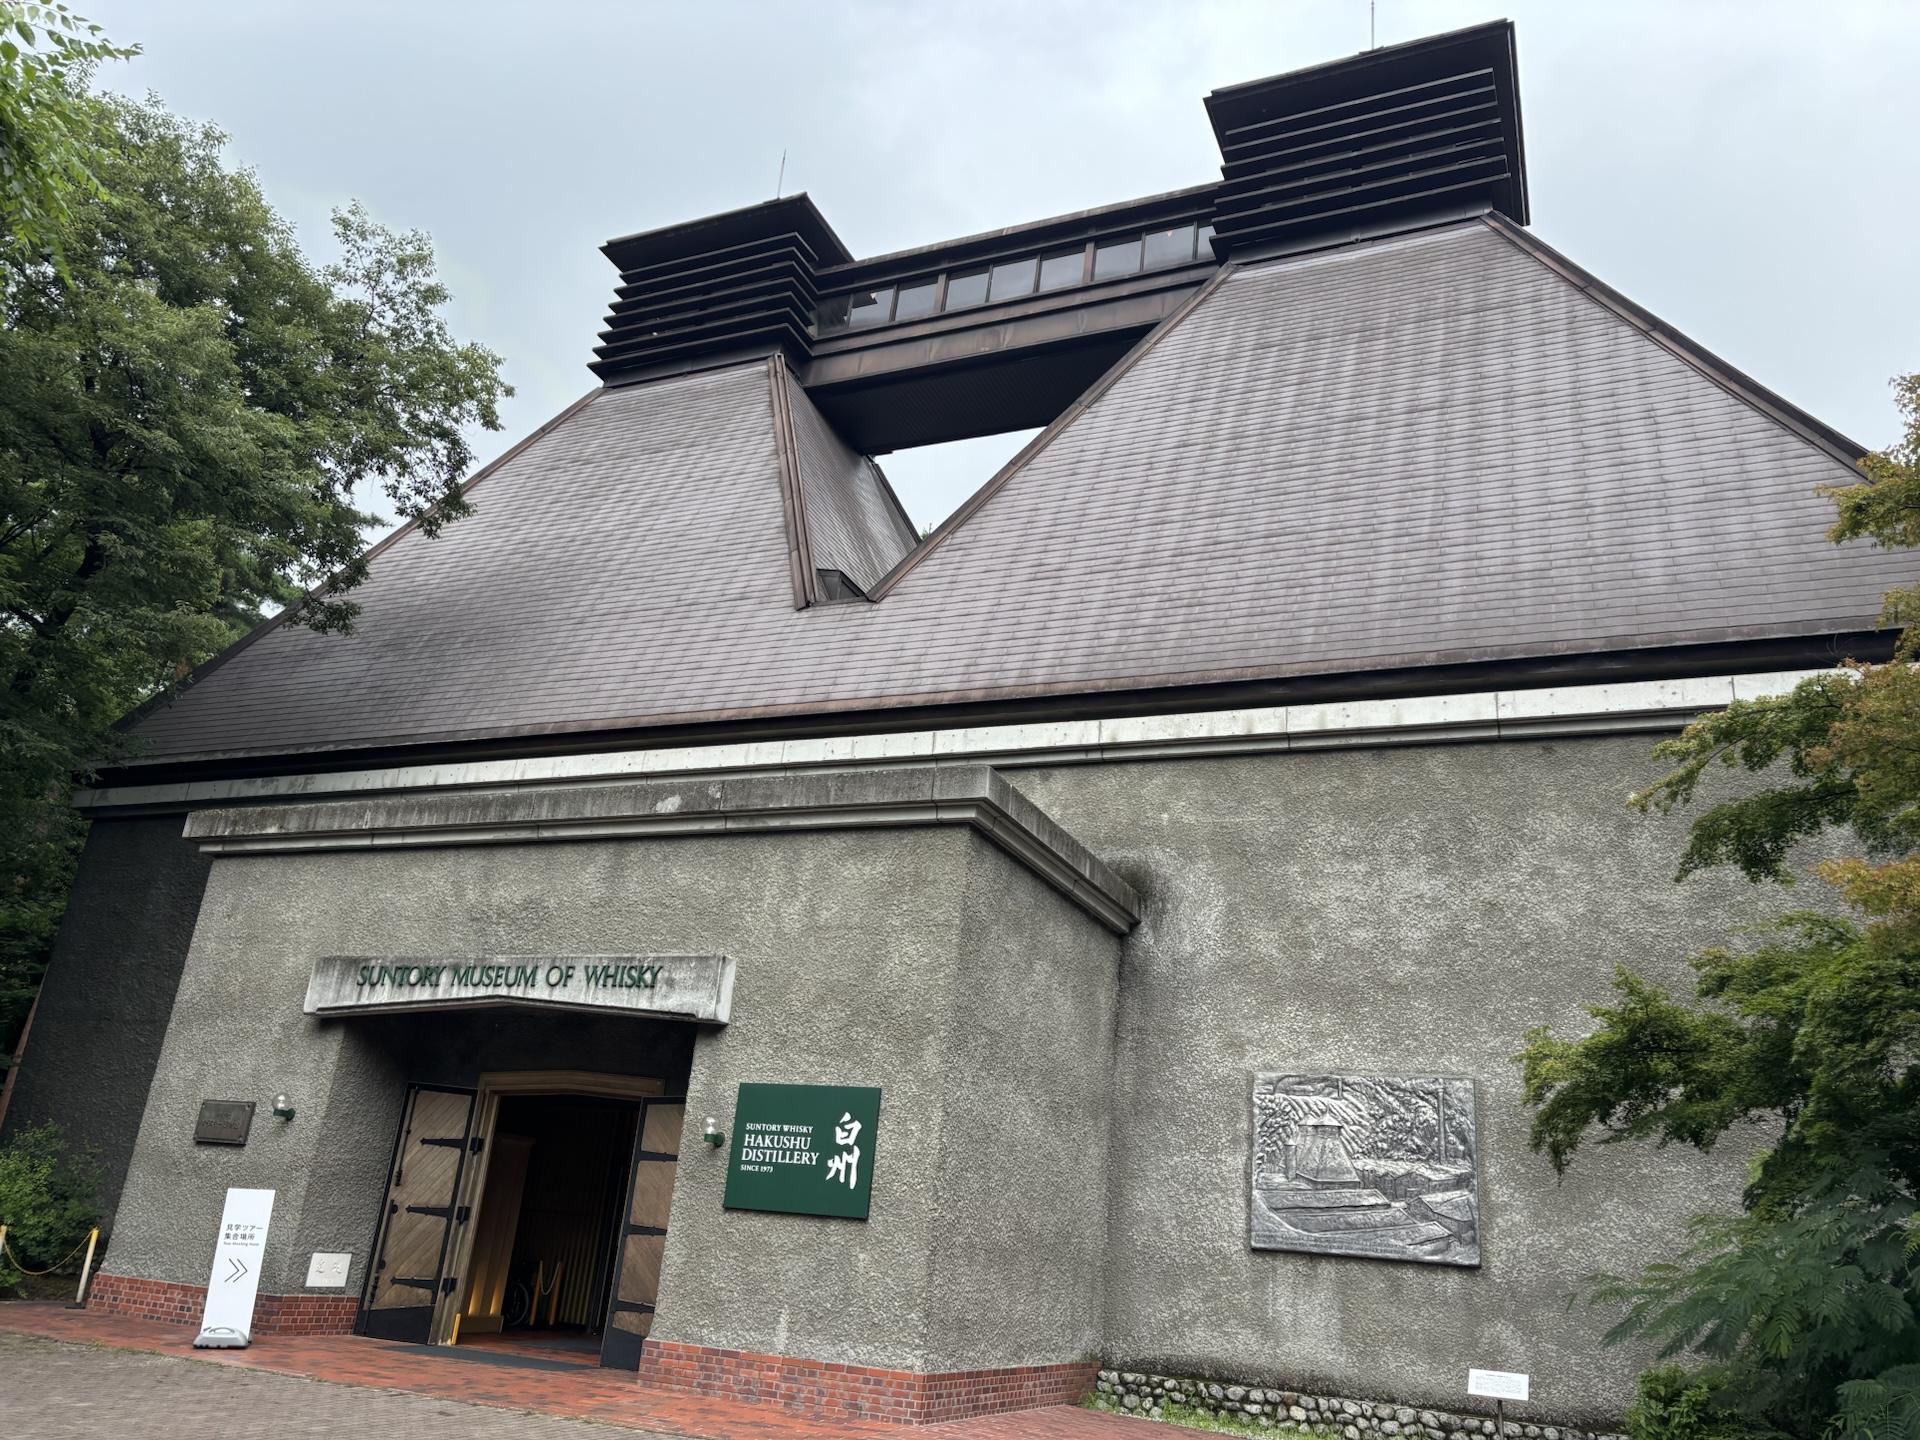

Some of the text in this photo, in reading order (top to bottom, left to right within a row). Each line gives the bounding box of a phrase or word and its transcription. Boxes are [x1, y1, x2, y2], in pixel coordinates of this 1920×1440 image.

[356, 965, 663, 987] SUNTORY MUSEUM OF WHISKY
[745, 1123, 814, 1134] SUNTORY WHISKY
[744, 1134, 812, 1149] HAKUSHU
[741, 1148, 819, 1165] DISTILLERY
[825, 1112, 862, 1190] 白州
[224, 1232, 255, 1240] 集合場所
